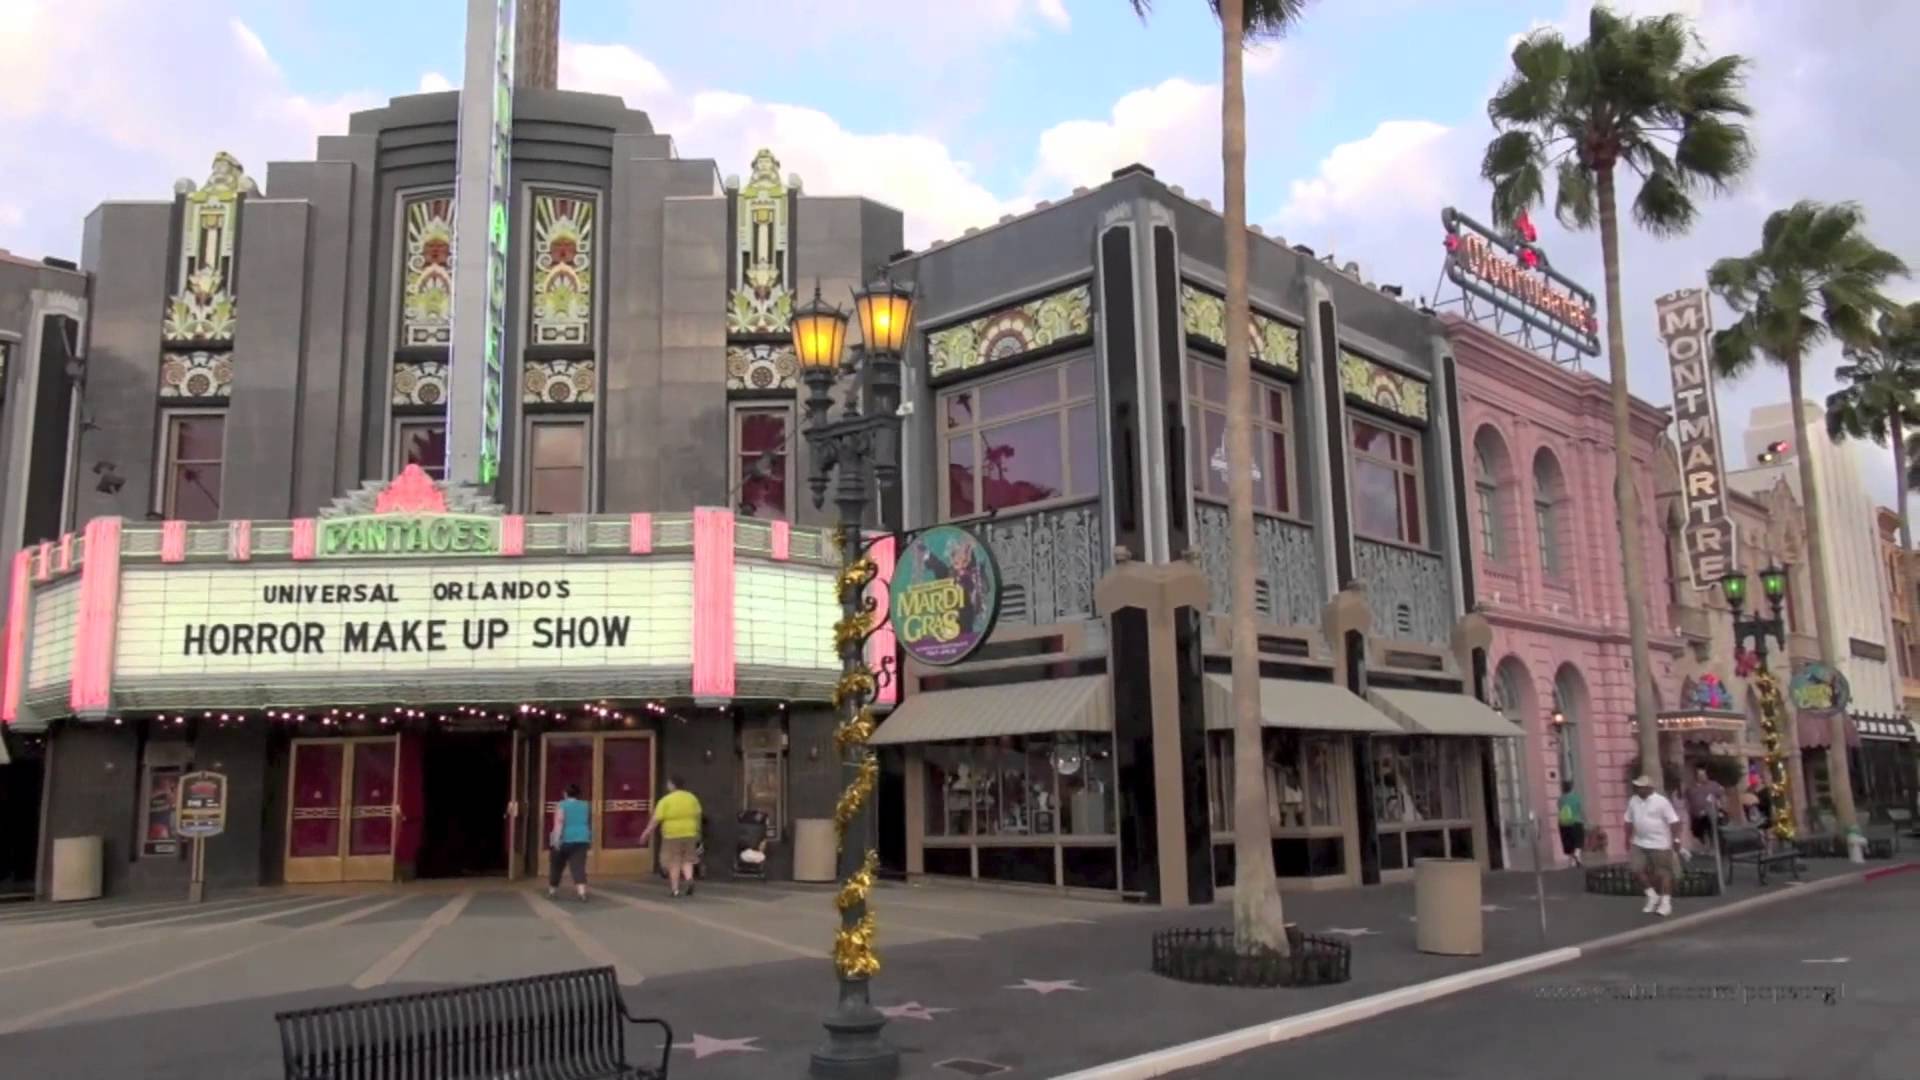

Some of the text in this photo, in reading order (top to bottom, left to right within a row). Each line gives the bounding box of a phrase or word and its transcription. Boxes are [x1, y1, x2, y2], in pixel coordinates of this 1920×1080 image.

[1665, 307, 1726, 581] MONTMARTRE
[263, 580, 570, 603] UNIVERSAL ORLANDO'S
[897, 584, 964, 617] MARDI
[184, 615, 631, 655] HORROR MAKE UP SHOW
[904, 610, 961, 642] GRAS
